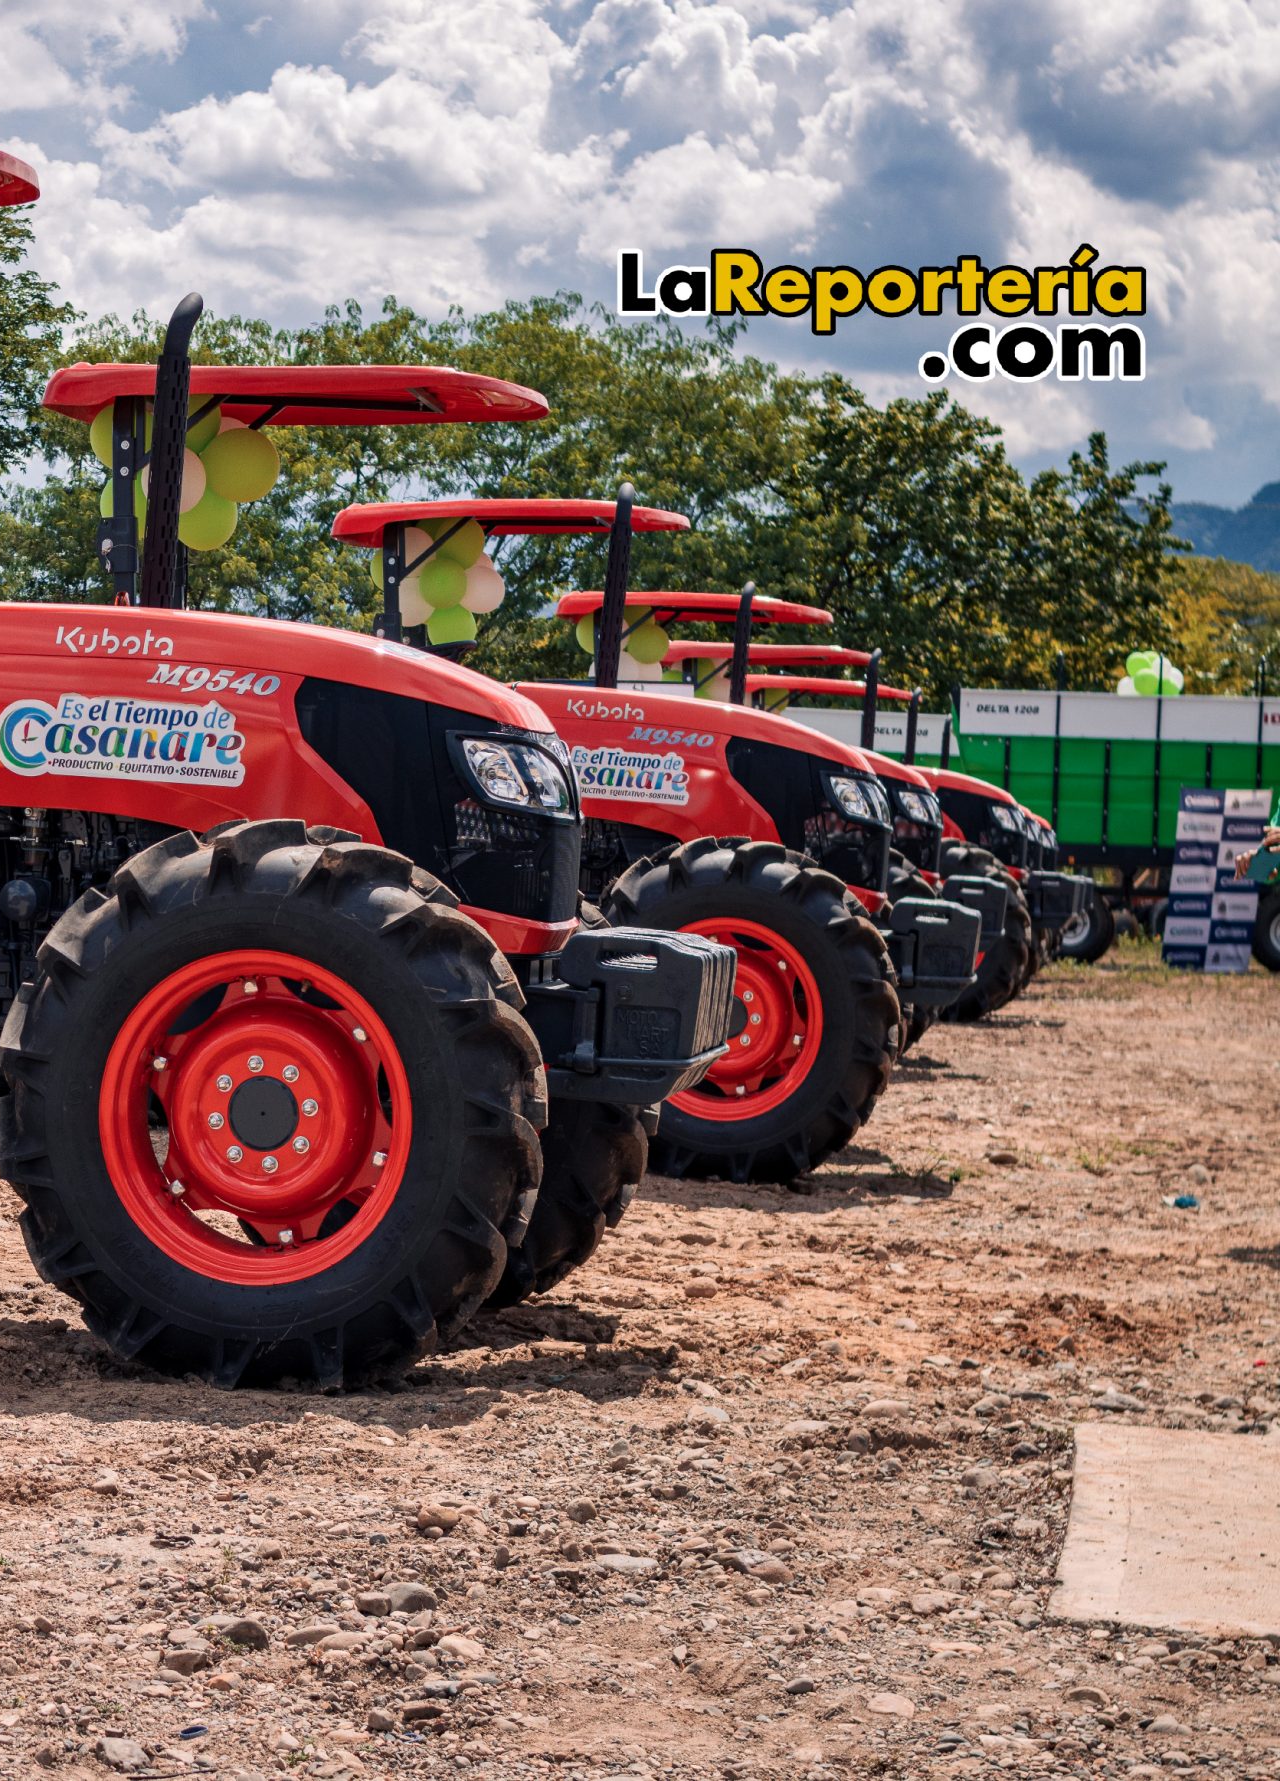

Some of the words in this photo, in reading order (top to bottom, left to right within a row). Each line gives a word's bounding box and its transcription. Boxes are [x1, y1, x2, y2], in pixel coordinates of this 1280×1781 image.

[56, 626, 174, 656] Kubota
[147, 664, 280, 696] M9540
[61, 698, 83, 720] Es
[89, 700, 107, 722] el
[115, 701, 198, 730] Tiempo
[204, 707, 230, 729] de
[567, 699, 644, 721] Kubota
[976, 704, 1009, 714] DELTA
[1014, 705, 1040, 715] 1208
[0, 706, 242, 769] Casanare
[628, 727, 714, 747] M9540
[573, 750, 587, 763] Es
[591, 751, 605, 765] el
[607, 752, 660, 771] Tiempo
[663, 757, 681, 770] de
